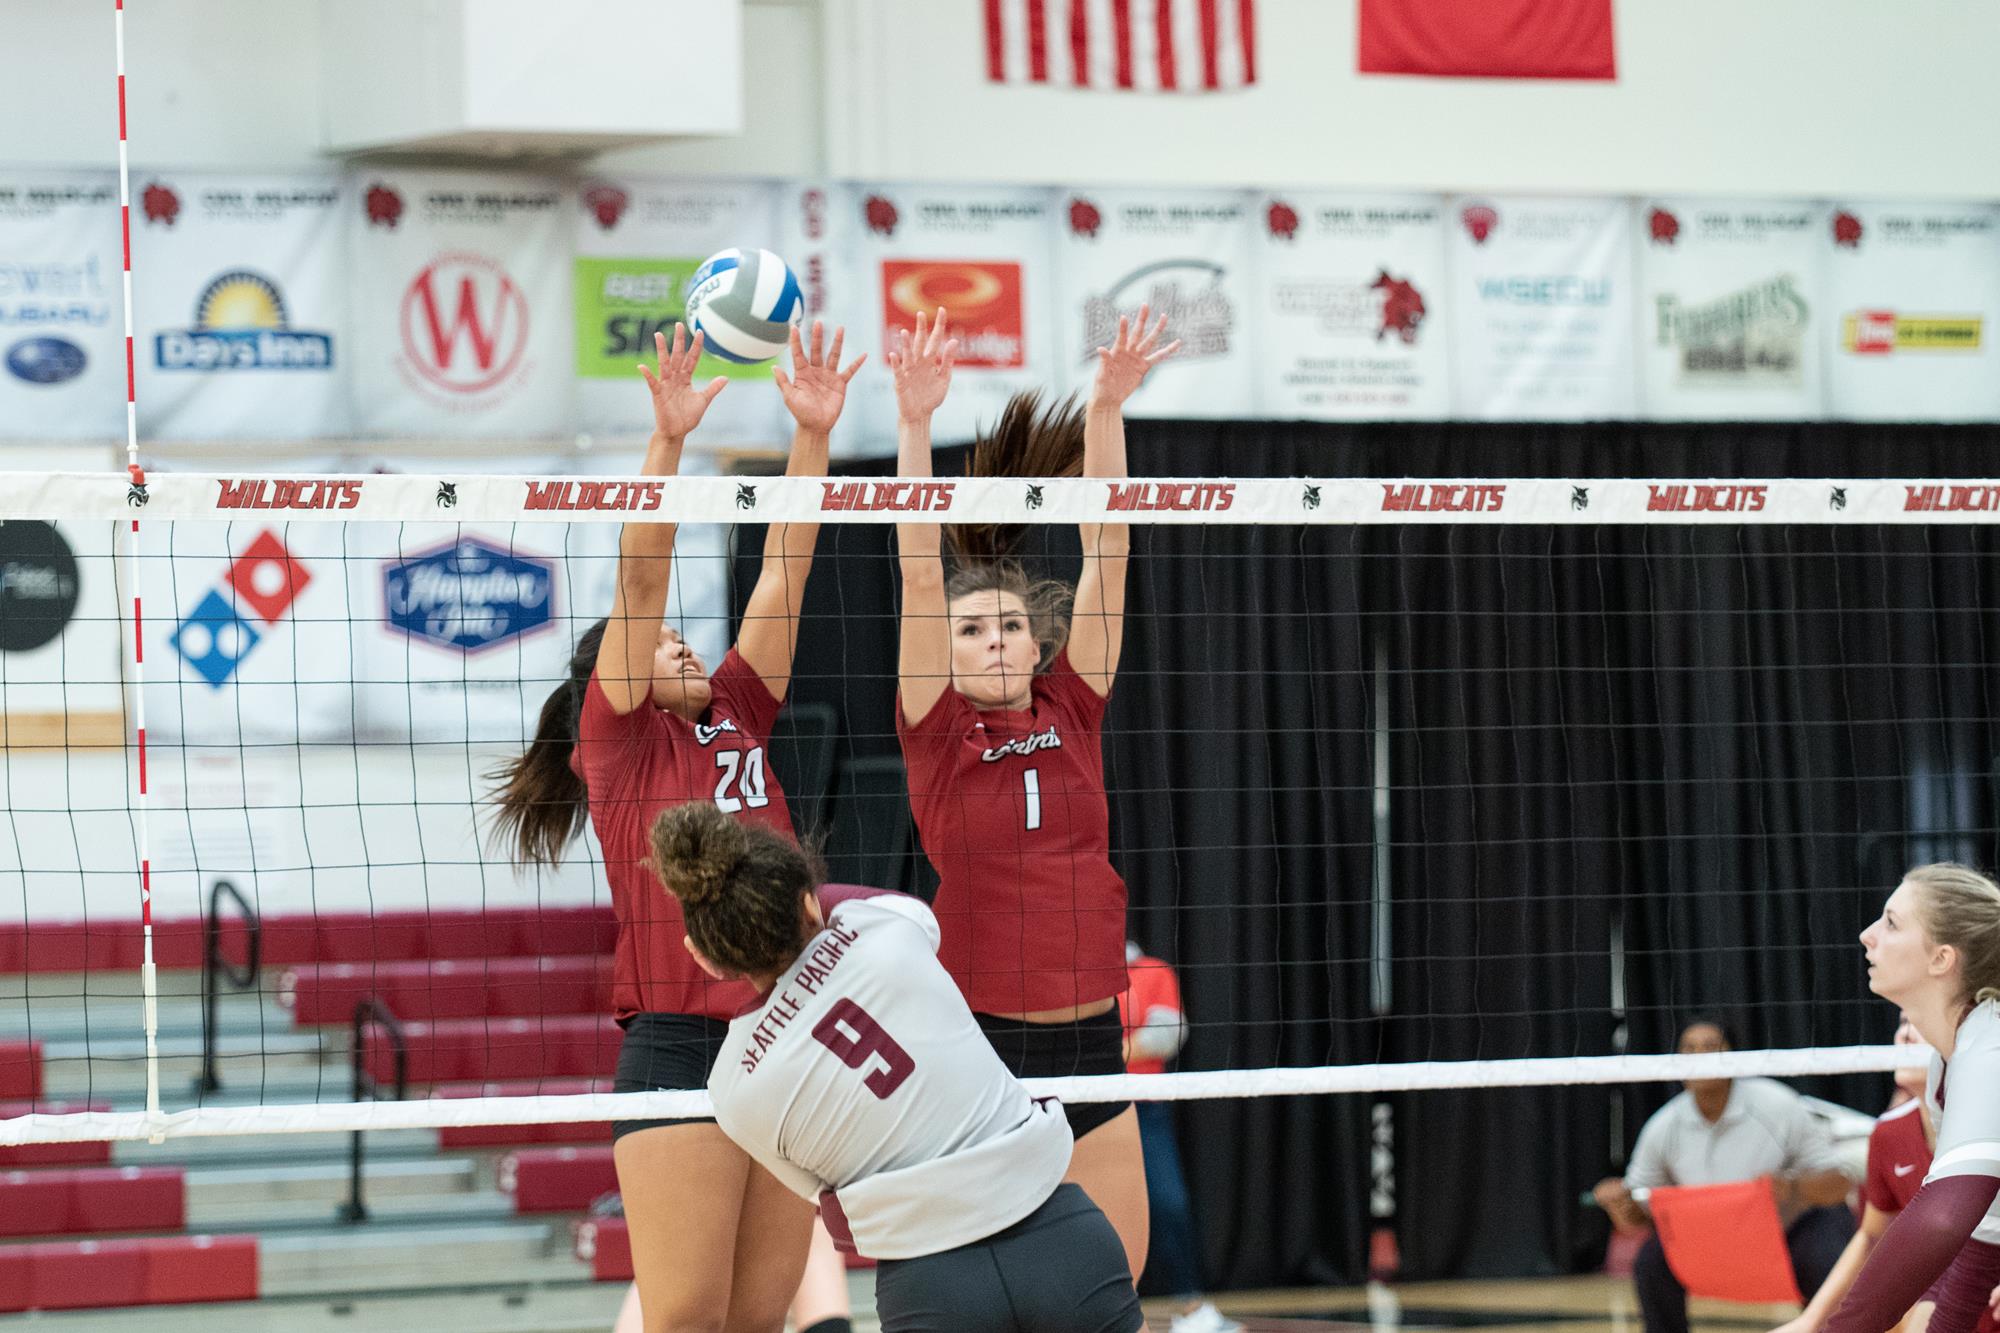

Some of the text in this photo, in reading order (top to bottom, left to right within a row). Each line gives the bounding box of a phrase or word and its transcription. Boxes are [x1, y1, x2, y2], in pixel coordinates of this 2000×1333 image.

[218, 480, 362, 509] WILDCATS
[525, 483, 663, 510] WILDCATS
[821, 484, 954, 511] WILDCATS
[1107, 485, 1234, 511] WILDCATS
[1382, 486, 1505, 511] WILDCATS
[1647, 486, 1768, 511] WILDCATS
[713, 745, 769, 814] 20
[1023, 767, 1041, 831] 1
[740, 922, 860, 1075] SEATTLE PACIFIC
[811, 996, 917, 1101] 9
